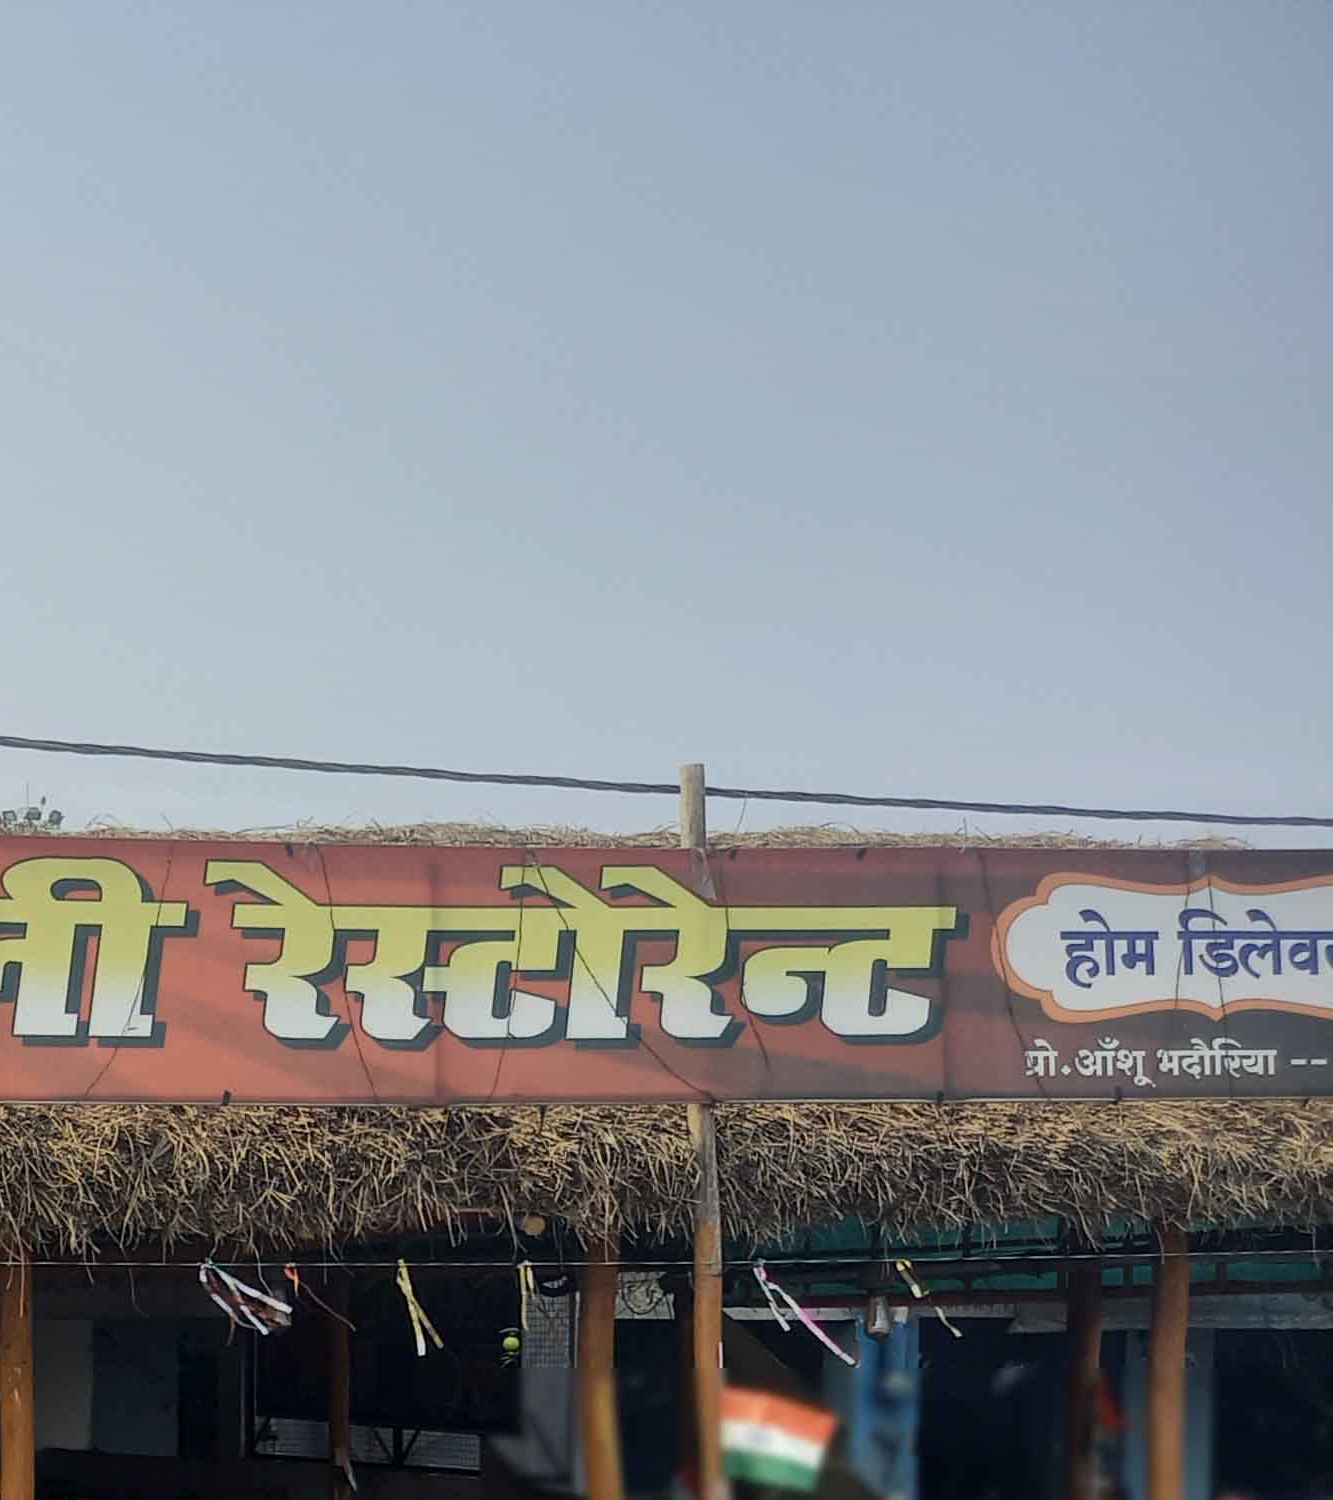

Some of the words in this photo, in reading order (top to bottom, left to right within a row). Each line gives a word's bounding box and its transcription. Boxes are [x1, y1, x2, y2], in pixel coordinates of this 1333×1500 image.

[204, 859, 956, 1040] रेस्टोरेन्ट
[1060, 908, 1159, 989] होम
[1177, 907, 1333, 979] डिलेव
[1156, 1037, 1278, 1079] भदौरिया
